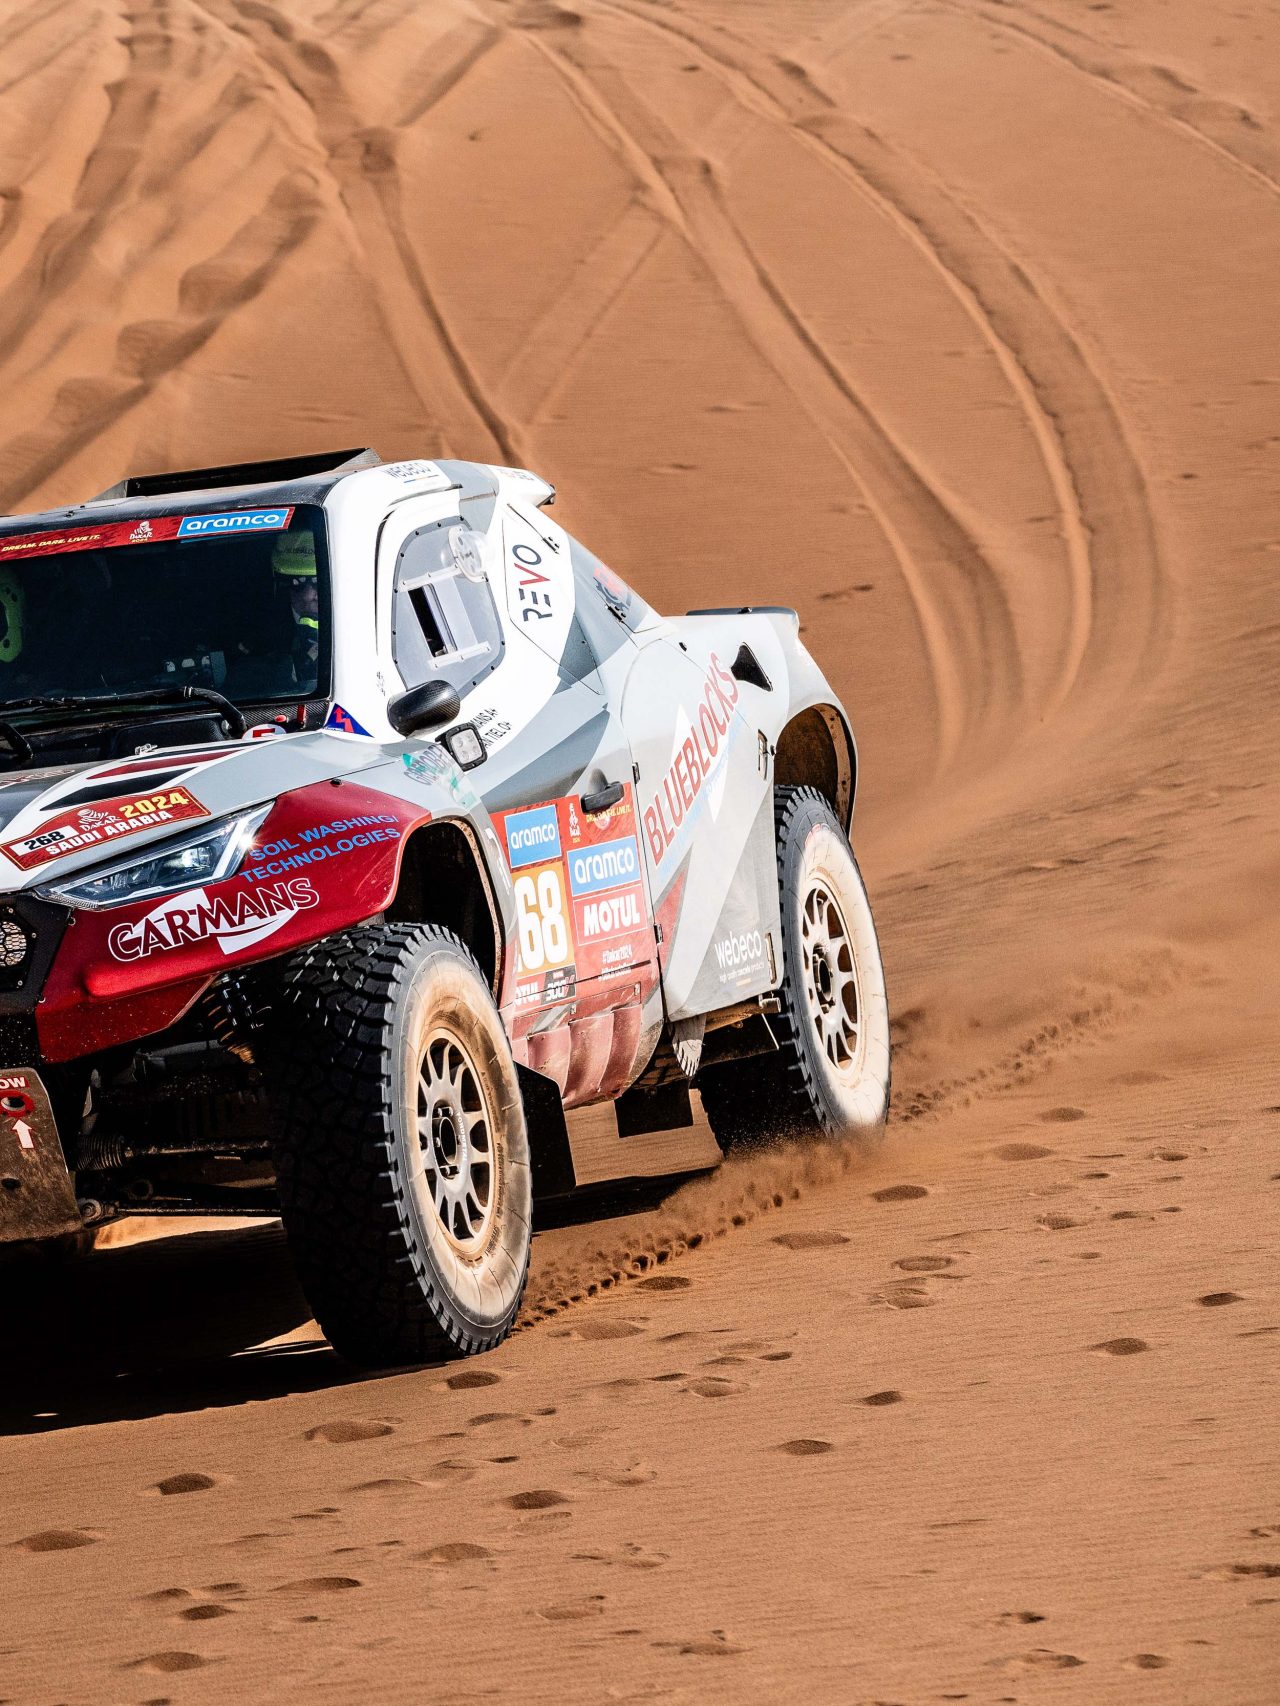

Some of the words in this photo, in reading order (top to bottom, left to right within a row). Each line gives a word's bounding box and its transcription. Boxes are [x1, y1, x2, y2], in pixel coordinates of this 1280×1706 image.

[129, 532, 153, 540] DAKAR
[186, 514, 280, 531] aramco
[2, 542, 37, 551] DREAM.
[39, 539, 66, 547] DARE.
[68, 535, 89, 543] LIVE
[512, 544, 552, 621] REVO
[643, 650, 739, 866] BLUEBLOCKS
[80, 815, 121, 832] DAKAR
[119, 793, 189, 819] 2024
[24, 831, 65, 851] 268
[45, 832, 103, 856] SAUDI
[106, 811, 173, 836] ARABIA
[250, 838, 300, 861] SOIL
[510, 823, 556, 850] aramco
[239, 828, 401, 883] TECHNOLOGIES
[574, 847, 635, 884] aramco
[108, 877, 320, 962] CARMANS
[514, 870, 568, 972] 68
[583, 893, 640, 937] MOTUL
[714, 930, 762, 969] webeco
